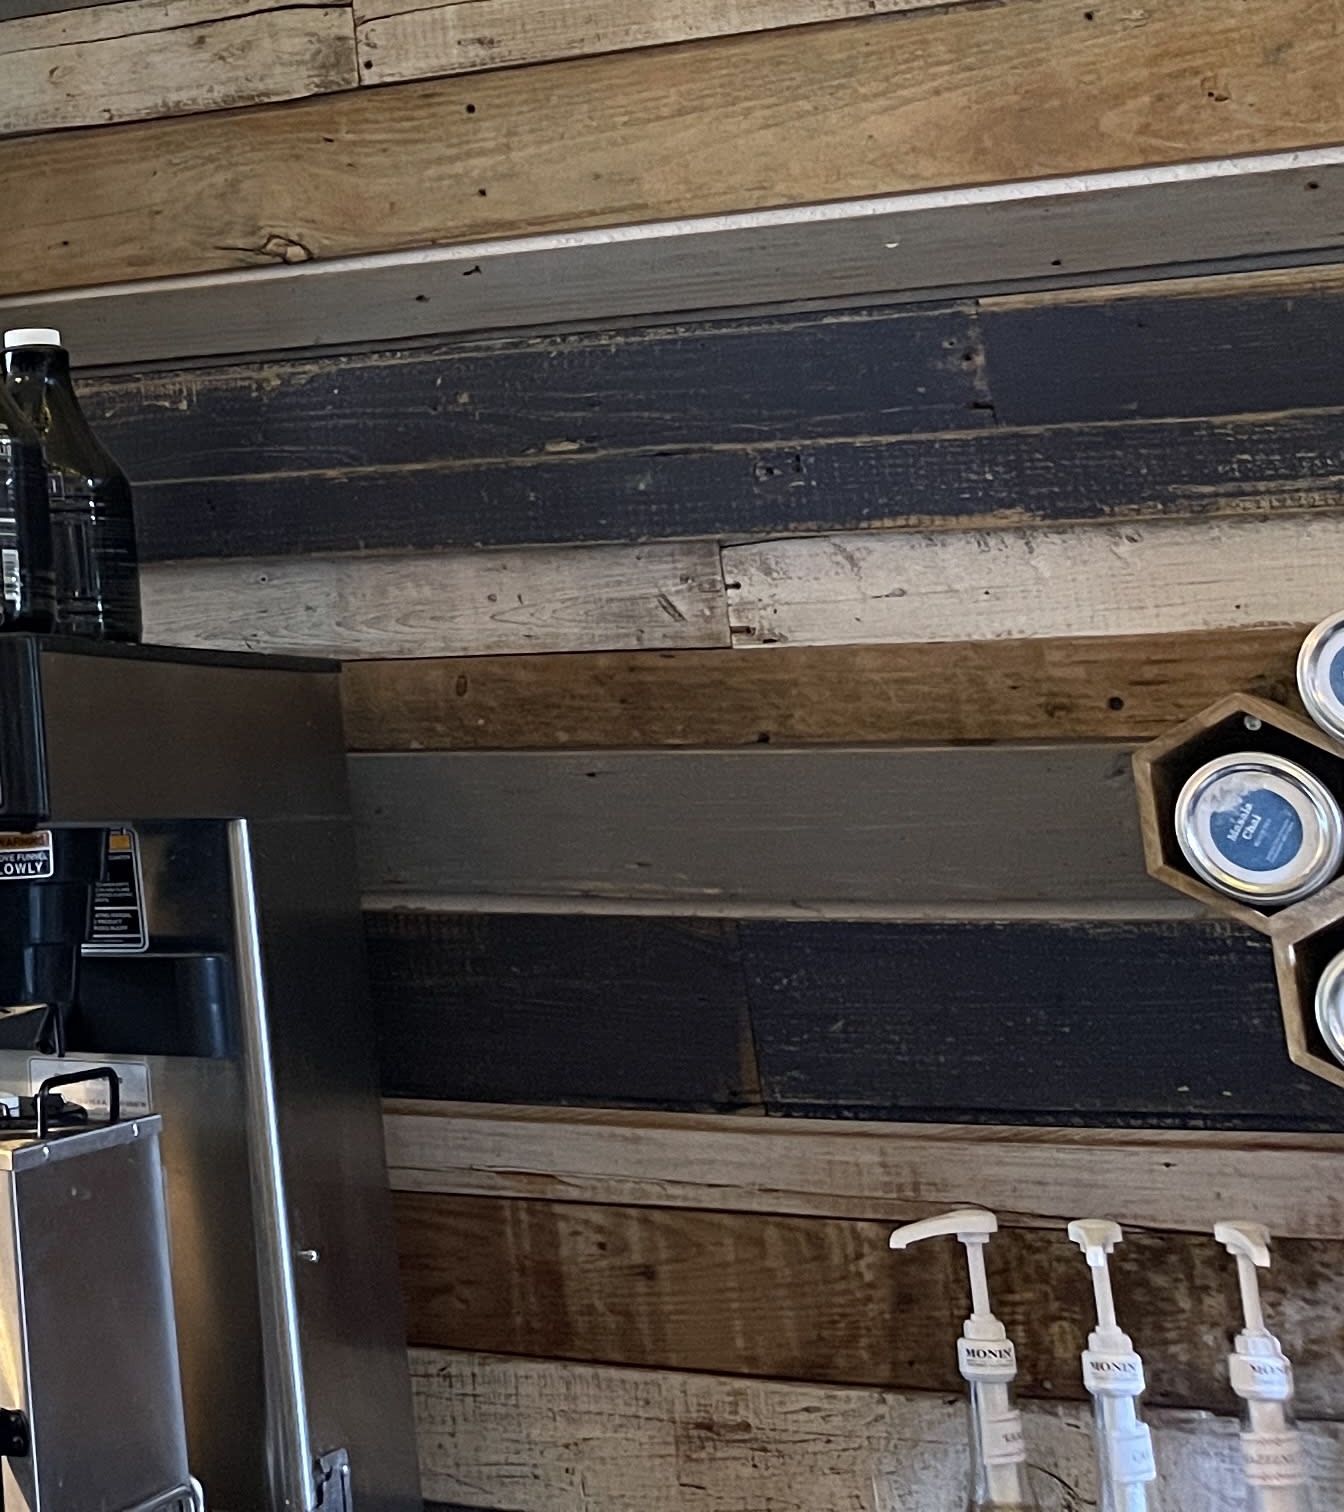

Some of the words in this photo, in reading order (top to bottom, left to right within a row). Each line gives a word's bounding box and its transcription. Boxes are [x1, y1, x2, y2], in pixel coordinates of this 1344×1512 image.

[1241, 813, 1262, 840] Chai
[966, 1348, 1012, 1359] MONIN
[1089, 1361, 1136, 1373] MONIN
